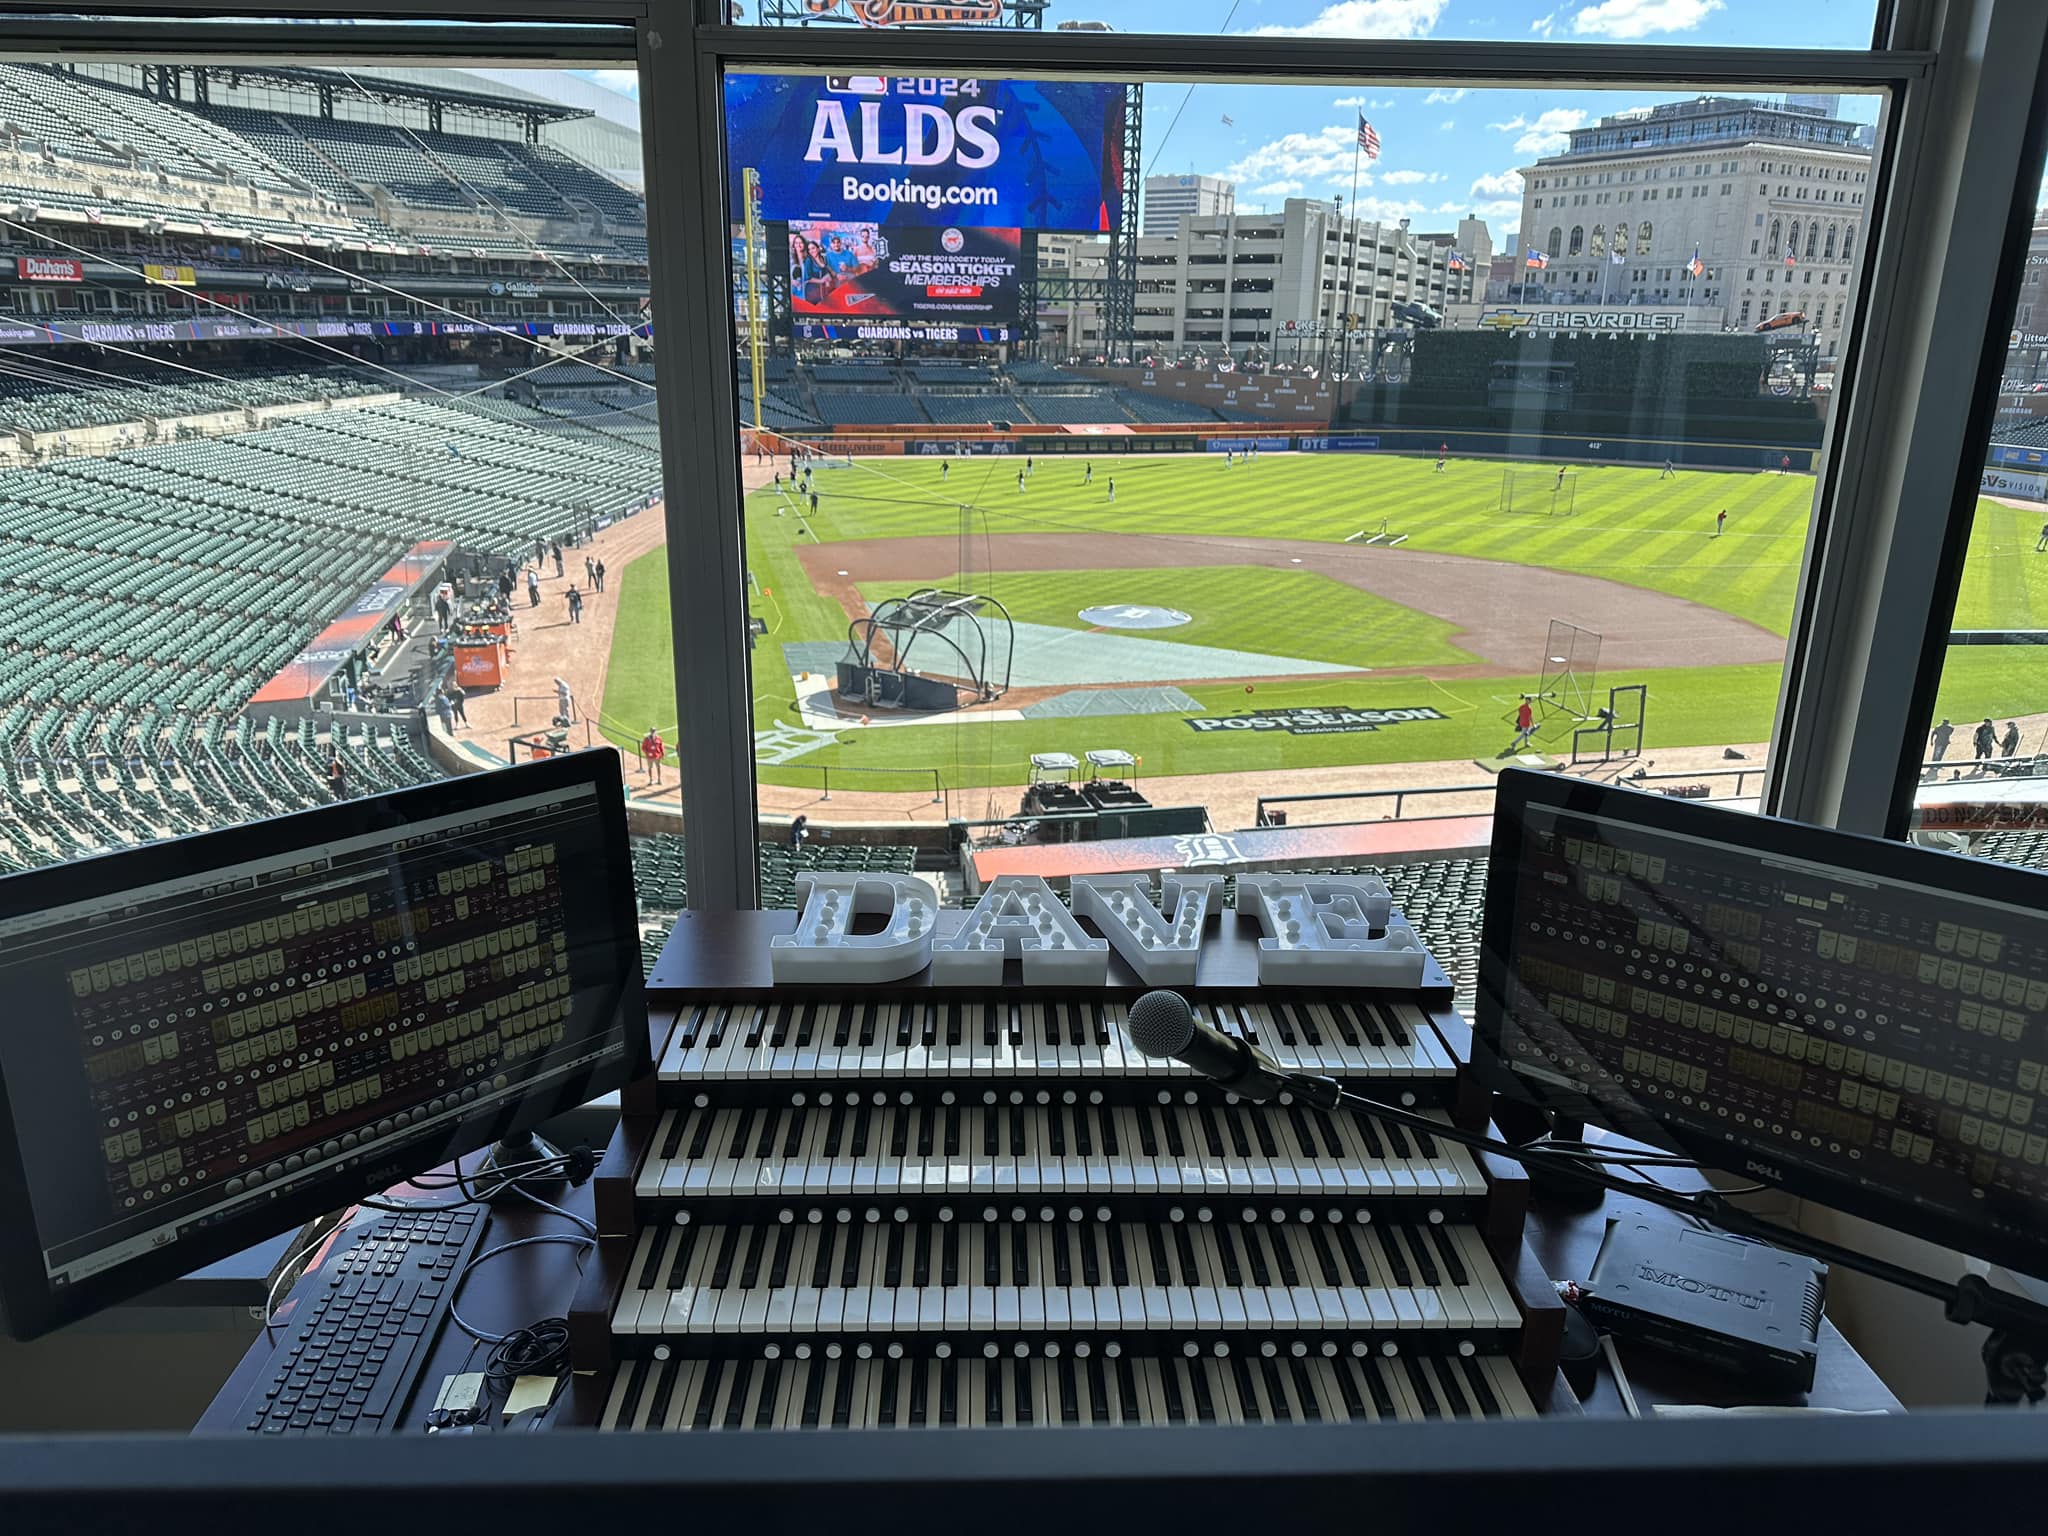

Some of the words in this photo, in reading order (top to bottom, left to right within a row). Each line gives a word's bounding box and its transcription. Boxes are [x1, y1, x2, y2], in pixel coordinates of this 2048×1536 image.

[896, 76, 980, 97] 2024
[803, 99, 1001, 169] ALDS
[842, 176, 998, 209] Booking.com
[26, 258, 75, 276] Dunham's
[889, 261, 957, 274] SEASON
[958, 264, 1015, 276] TICKET
[505, 281, 544, 293] Gallagher
[904, 274, 1001, 288] MEMBERSHIPS
[455, 324, 474, 333] ALDS
[1279, 319, 1320, 331] ROCKET
[1537, 312, 1684, 329] CHEVROLET
[81, 324, 134, 342] GUARDIANS
[145, 324, 176, 340] TIGERS
[553, 323, 596, 336] GUARDIANS
[606, 324, 632, 336] TIGERS
[857, 326, 911, 340] GUARDIANS
[912, 329, 924, 339] vs
[925, 328, 958, 340] TIGERS
[1508, 330, 1657, 341] FOUNTAIN
[1302, 438, 1329, 450] DTE
[1192, 708, 1442, 731] POSTSEASON
[770, 871, 1429, 989] DAVE
[1745, 1160, 1783, 1181] DELL
[1638, 1265, 1766, 1309] MOTU
